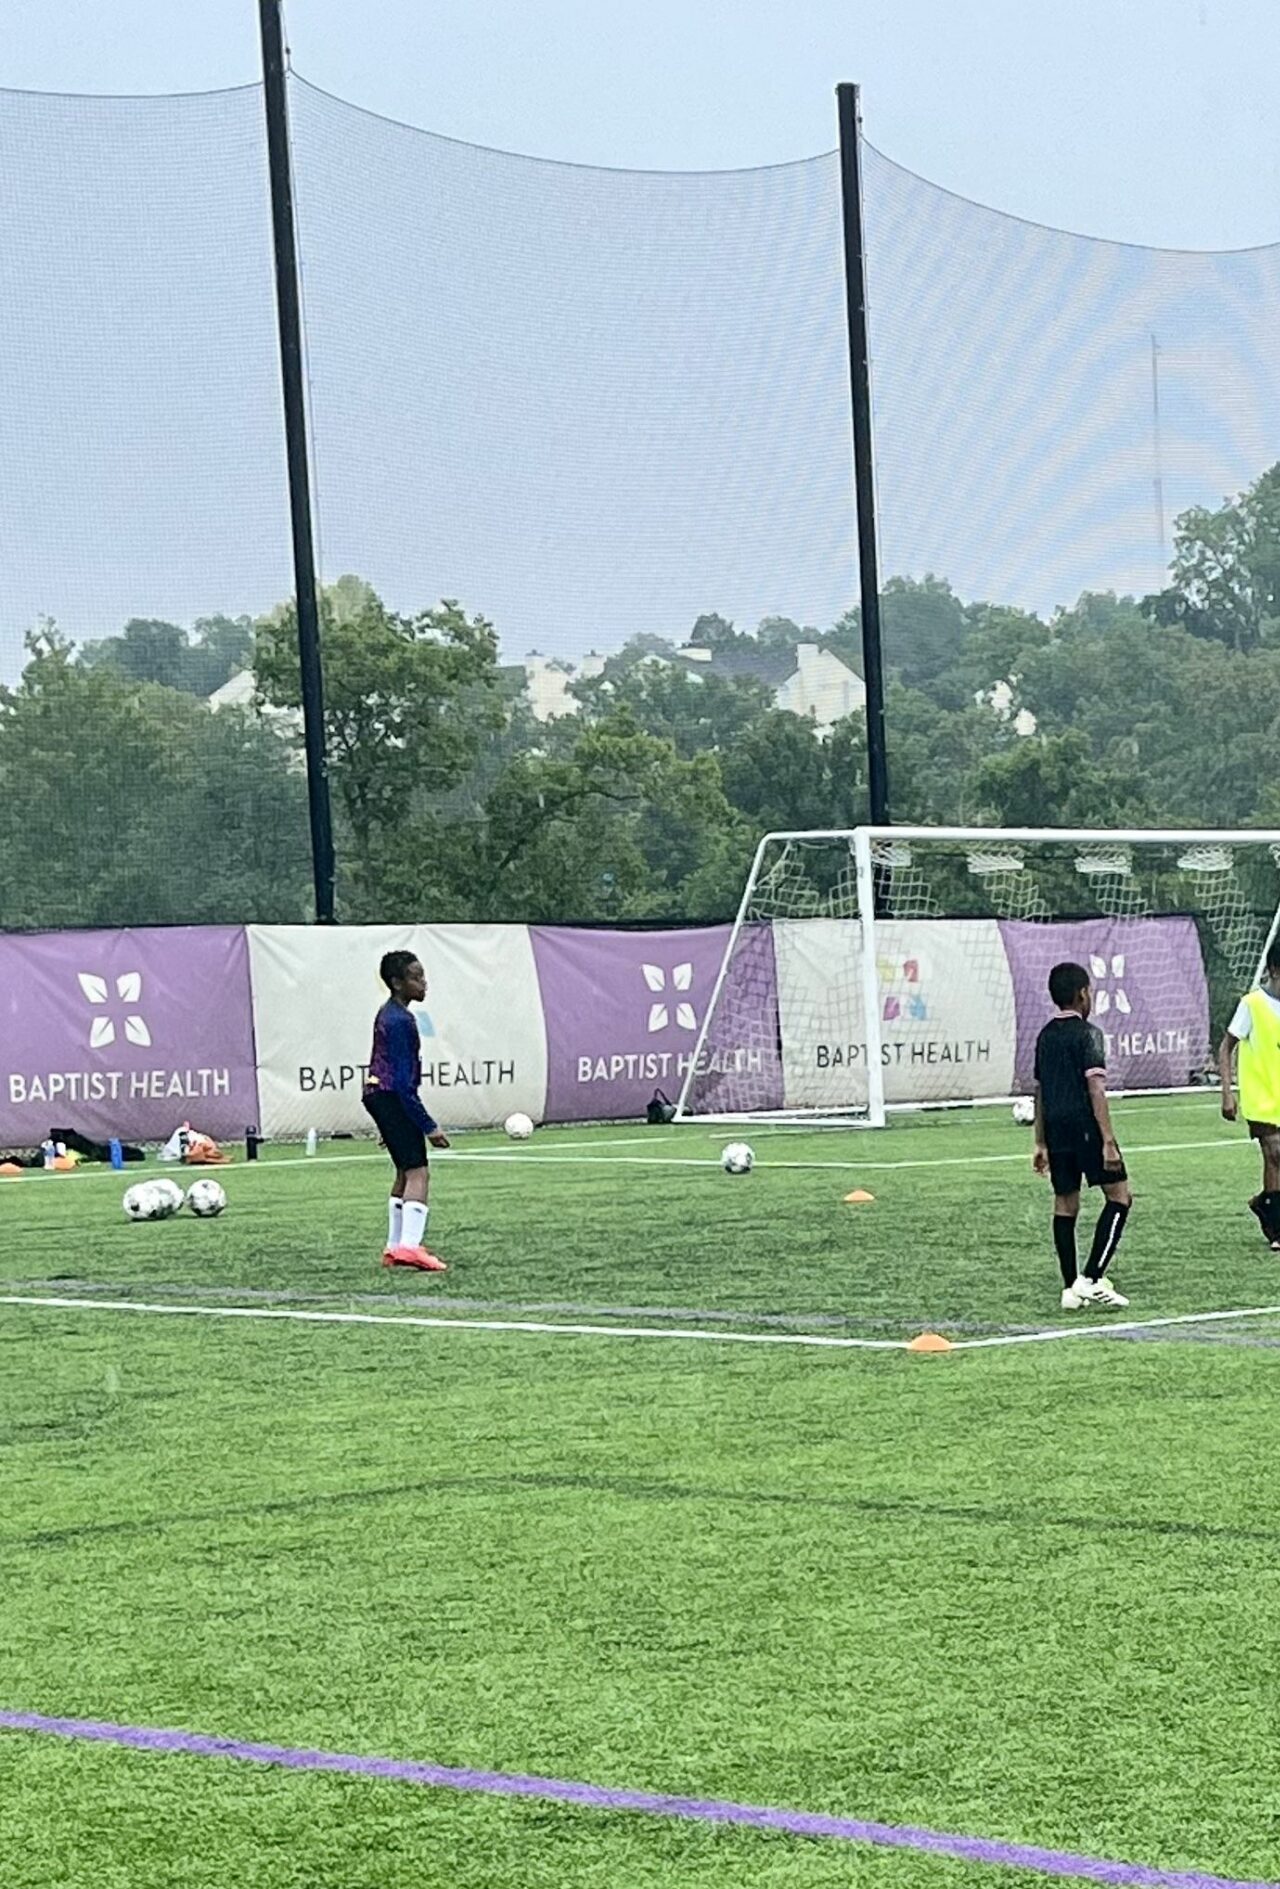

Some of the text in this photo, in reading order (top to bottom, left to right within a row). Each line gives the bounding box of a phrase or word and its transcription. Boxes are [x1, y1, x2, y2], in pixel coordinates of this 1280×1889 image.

[817, 1040, 990, 1068] BAPTST HEALTH
[1118, 1030, 1188, 1056] HEALTH
[300, 1060, 515, 1091] BAPT HEALTH
[578, 1050, 762, 1082] BAPTIST HEALTH
[9, 1068, 230, 1103] BAPTIST HEALTH
